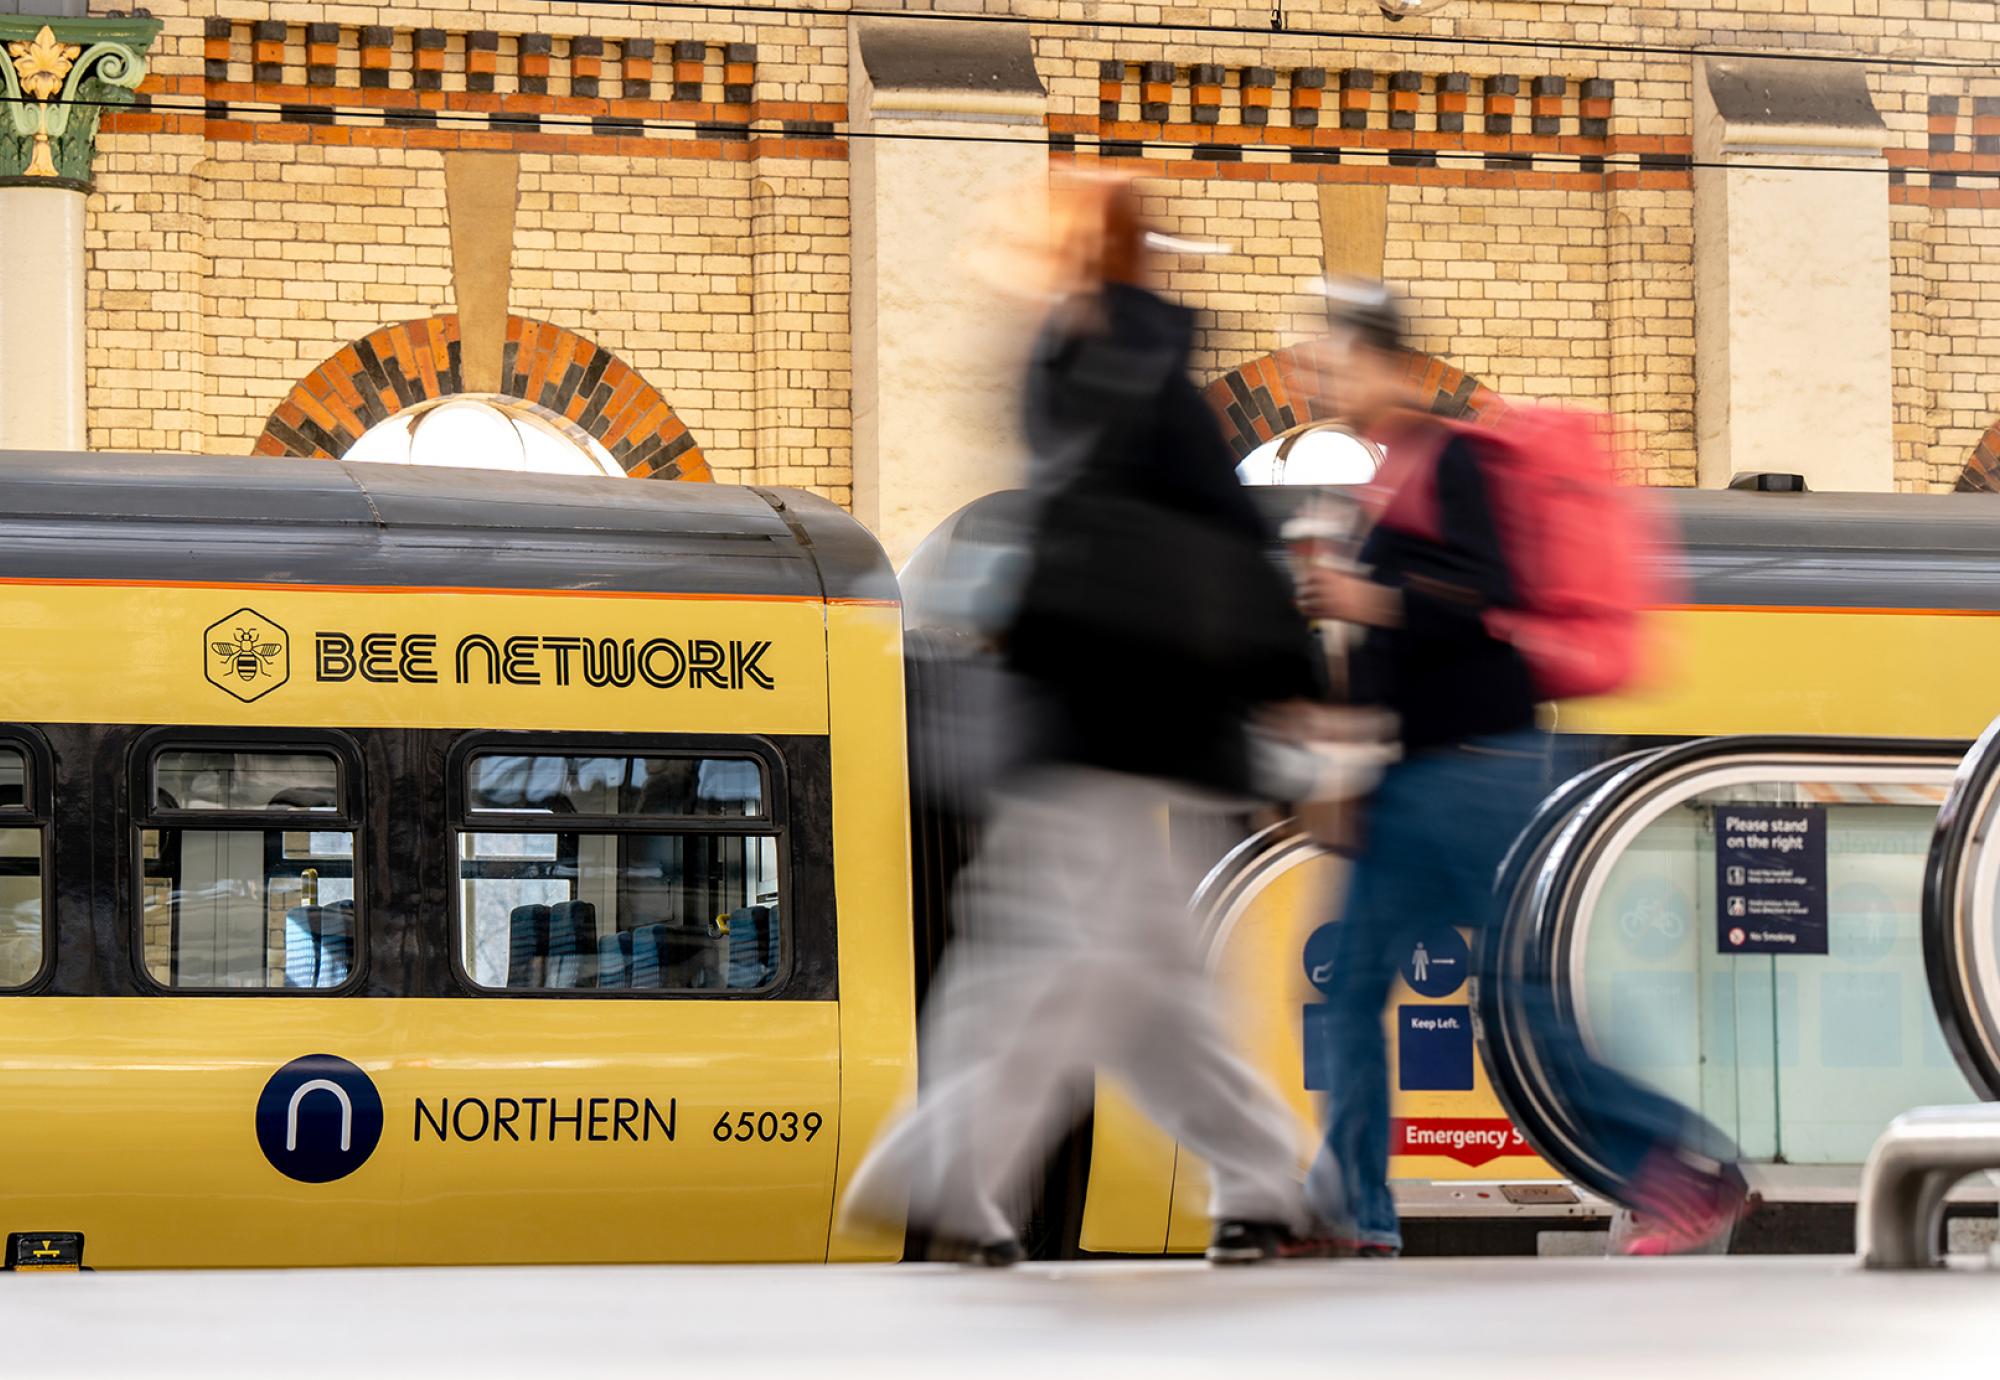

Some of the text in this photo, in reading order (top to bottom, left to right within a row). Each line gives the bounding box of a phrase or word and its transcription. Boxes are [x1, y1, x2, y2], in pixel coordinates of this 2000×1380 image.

[315, 631, 775, 691] BEE NETWORK
[1726, 816, 1808, 833] Please stand
[1726, 835, 1804, 853] on the right
[1411, 1018, 1460, 1030] Keep Left.
[413, 1097, 823, 1143] NORTHERN 65039
[1406, 1126, 1524, 1149] Emergency S
